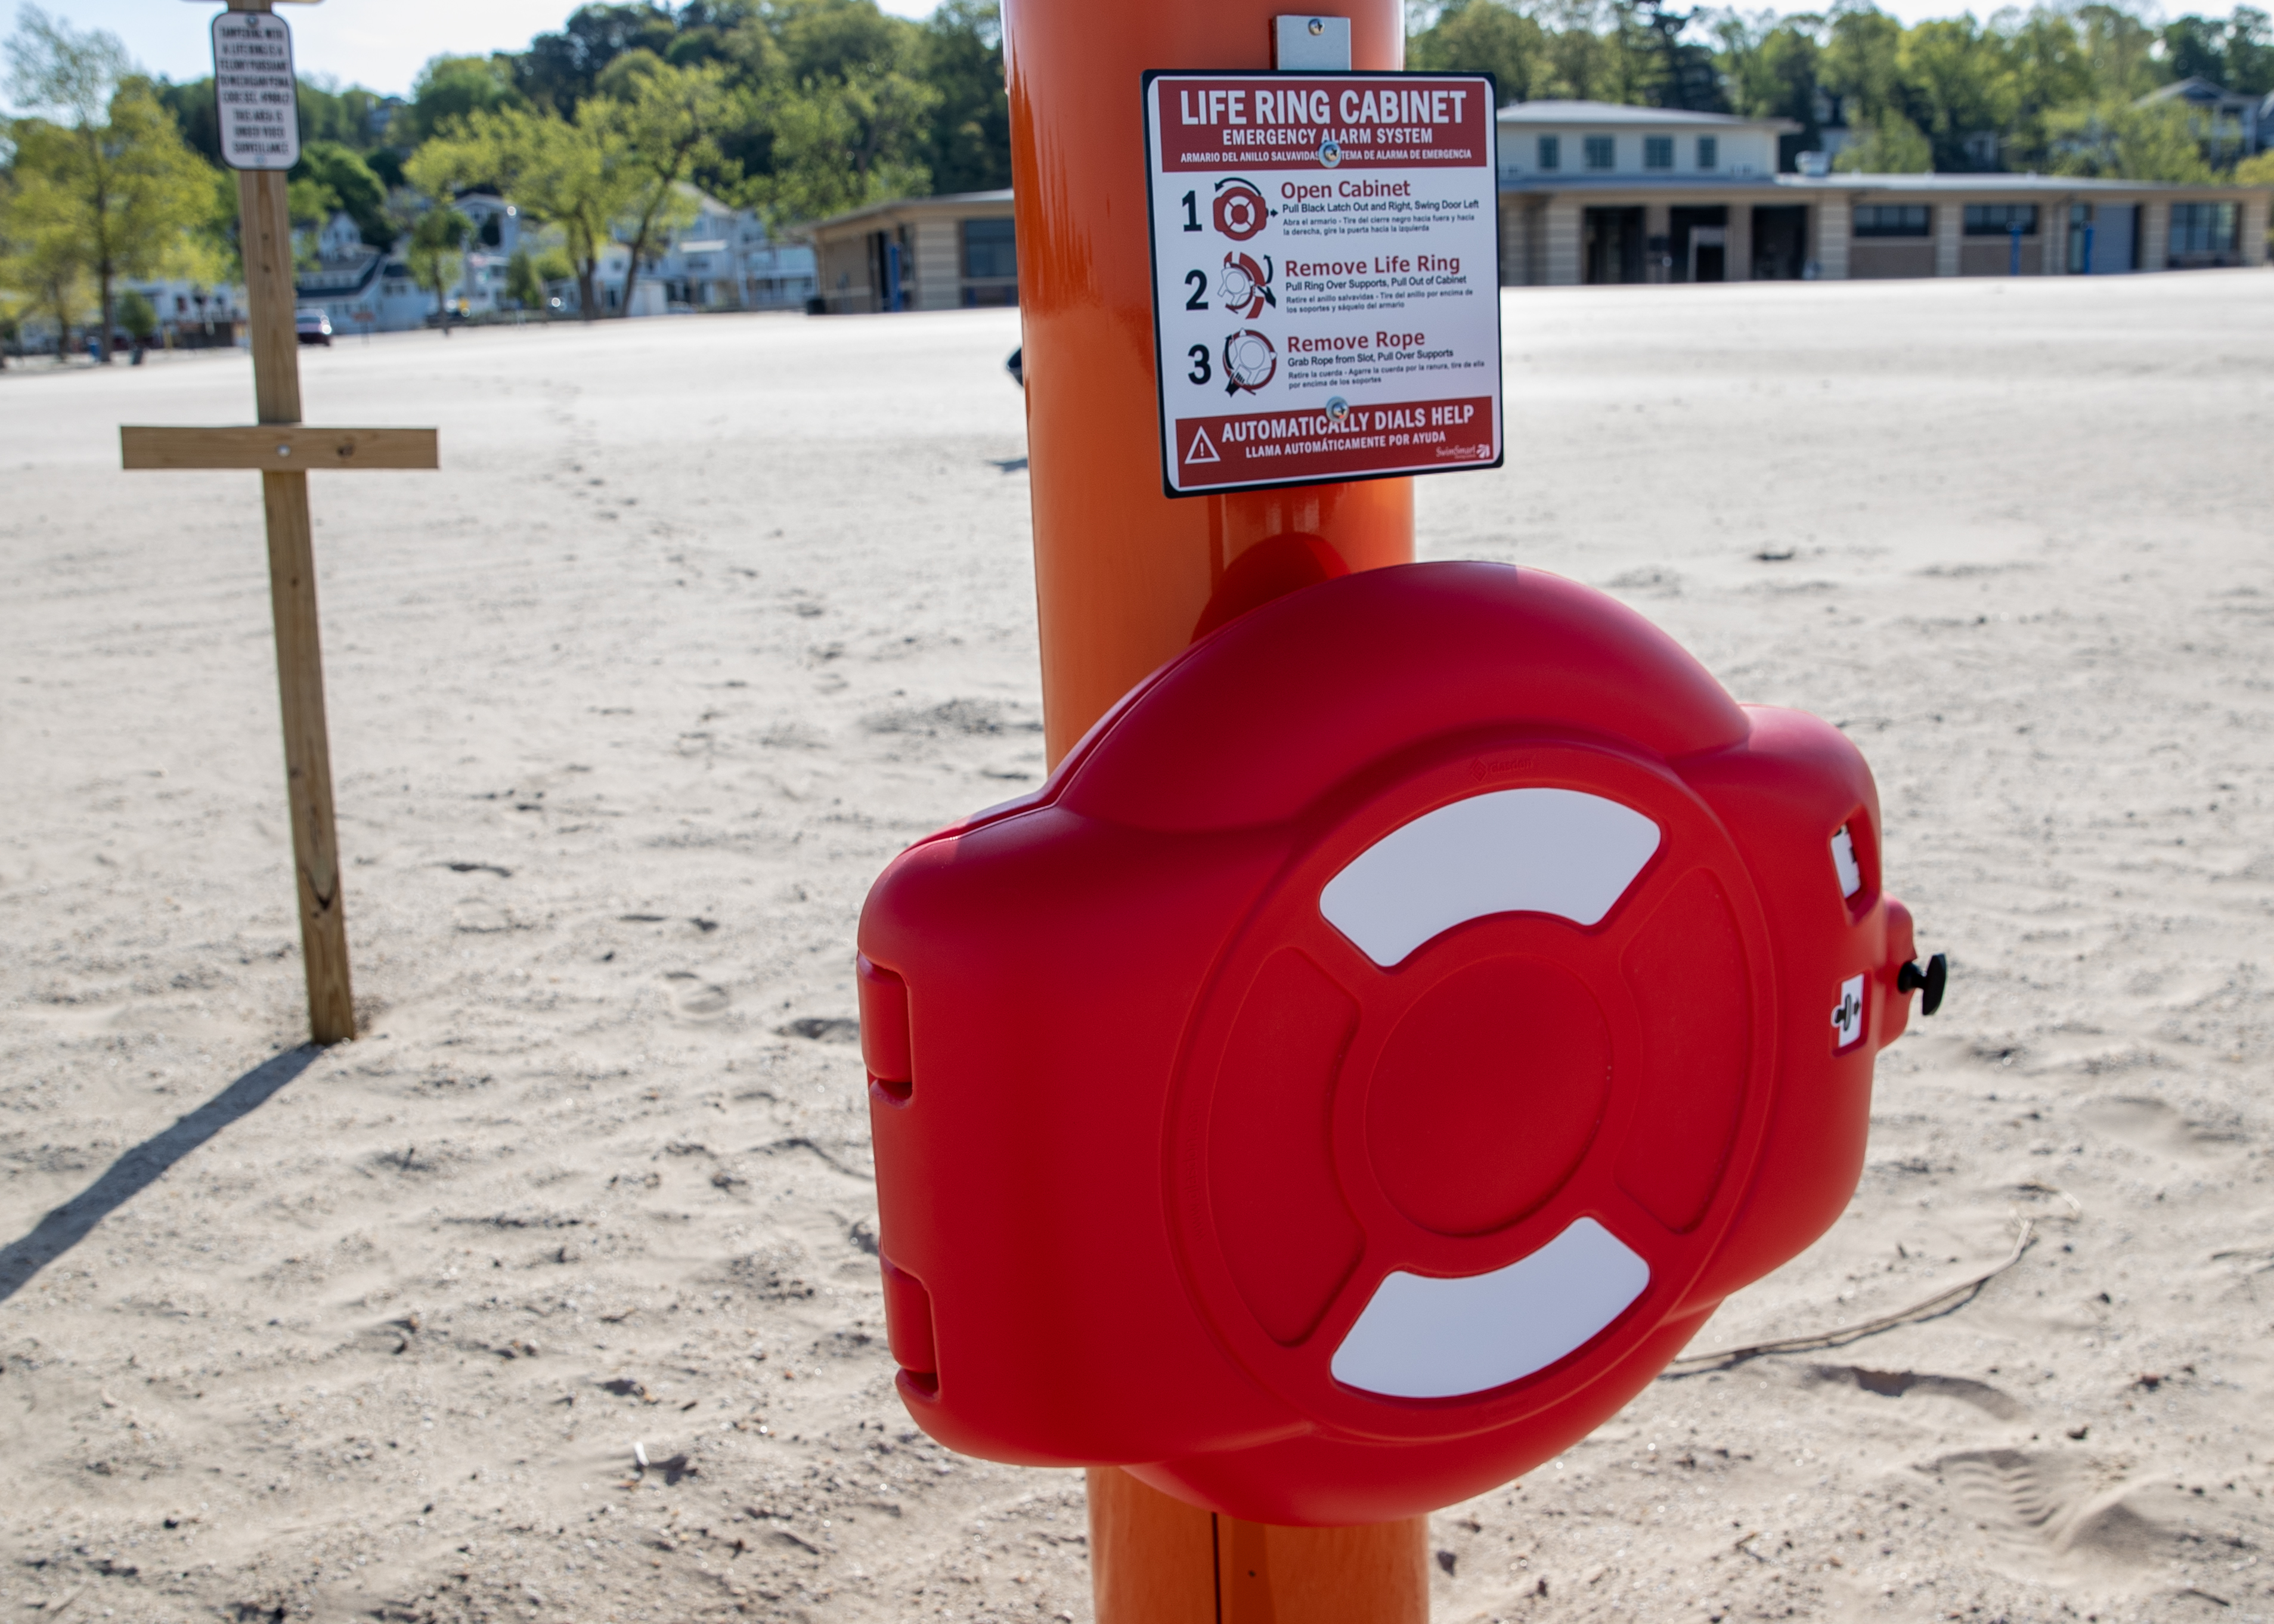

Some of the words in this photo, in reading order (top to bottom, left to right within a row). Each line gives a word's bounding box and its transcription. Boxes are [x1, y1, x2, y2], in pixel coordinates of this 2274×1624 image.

[1181, 90, 1247, 125] LIFE
[1255, 90, 1331, 124] RING
[1339, 90, 1467, 124] CABINET
[1223, 128, 1316, 145] EMERGENCY
[1321, 128, 1371, 144] ALARM
[1377, 128, 1433, 144] SYSTEM
[1181, 152, 1220, 163] ARMARIO
[1222, 151, 1238, 162] DEL
[1240, 151, 1269, 162] ANILLO
[1364, 150, 1374, 160] DE
[1376, 150, 1408, 160] ALARMA
[1410, 149, 1421, 160] DE
[1422, 148, 1472, 159] EMERGENCIA
[1281, 182, 1332, 203] Open
[1339, 179, 1411, 198] Cabinet
[1182, 190, 1203, 232] 1
[1282, 203, 1299, 213] Pull
[1302, 202, 1325, 213] Black
[1327, 202, 1351, 212] Latch
[1353, 202, 1369, 212] Out
[1371, 202, 1386, 211] and
[1389, 200, 1413, 213] Right,
[1414, 200, 1440, 212] Swing
[1442, 200, 1462, 209] Door
[1464, 199, 1479, 209] Left
[1310, 217, 1337, 225] armario
[1358, 216, 1369, 224] del
[1370, 215, 1390, 224] cierre
[1391, 216, 1411, 226] negro
[1324, 227, 1337, 236] gire
[1339, 226, 1345, 234] la
[1347, 226, 1369, 235] puerta
[1285, 261, 1367, 277] Remove
[1375, 255, 1411, 274] Life
[1418, 254, 1460, 275] Ring
[1185, 269, 1209, 311] 2
[1285, 281, 1302, 292] Pull
[1305, 281, 1324, 292] Ring
[1326, 279, 1347, 290] Over
[1349, 278, 1389, 290] Supports,
[1391, 277, 1407, 287] Pull
[1409, 276, 1424, 286] Out
[1426, 275, 1435, 285] of
[1436, 274, 1467, 285] Cabinet
[1287, 296, 1308, 304] Retire
[1317, 295, 1336, 303] anillo
[1380, 292, 1393, 300] Tire
[1427, 291, 1438, 300] por
[1288, 335, 1369, 354] Remove
[1376, 331, 1425, 351] Rope
[1188, 343, 1212, 385] 3
[1288, 357, 1309, 367] Grab
[1311, 355, 1334, 367] Rope
[1336, 354, 1355, 365] from
[1357, 353, 1376, 364] Slot,
[1377, 351, 1394, 362] Pull
[1395, 351, 1415, 361] Over
[1417, 349, 1454, 360] Supports
[1288, 371, 1309, 380] Retire
[1221, 412, 1370, 443] AUTOMATICALLY
[1375, 408, 1426, 431] DIALS
[1431, 404, 1474, 427] HELP
[1246, 444, 1282, 458] LLAMA
[1284, 435, 1386, 455] AUTOMÁTICAMENTE
[1389, 433, 1410, 446] POR
[1412, 430, 1446, 445] AYUDA
